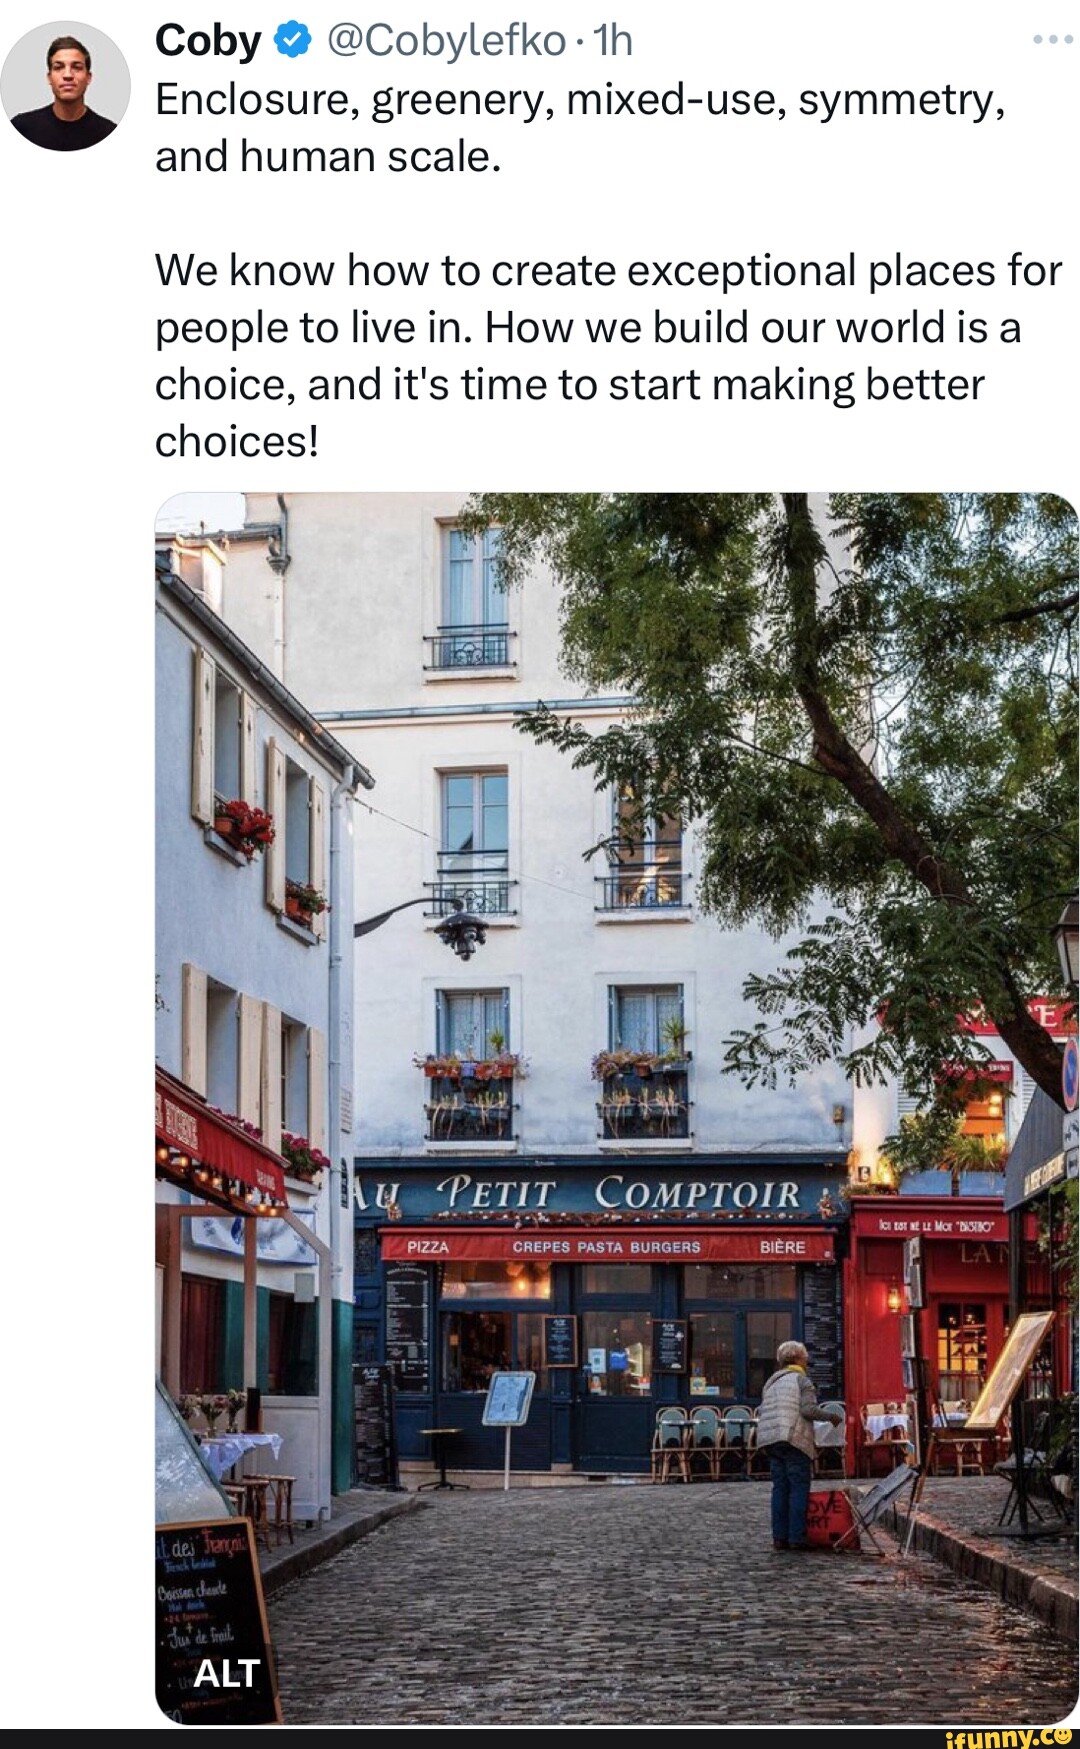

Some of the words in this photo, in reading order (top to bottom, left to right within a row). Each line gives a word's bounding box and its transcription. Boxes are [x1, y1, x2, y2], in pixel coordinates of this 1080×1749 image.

[436, 1173, 556, 1208] PETIT
[595, 1174, 800, 1209] COMPTOIR
[407, 1240, 449, 1254] PIZZA
[512, 1240, 570, 1254] CREPES
[577, 1240, 623, 1254] PASTA
[630, 1240, 702, 1254] BURGERS
[760, 1237, 806, 1254] BIÈRE
